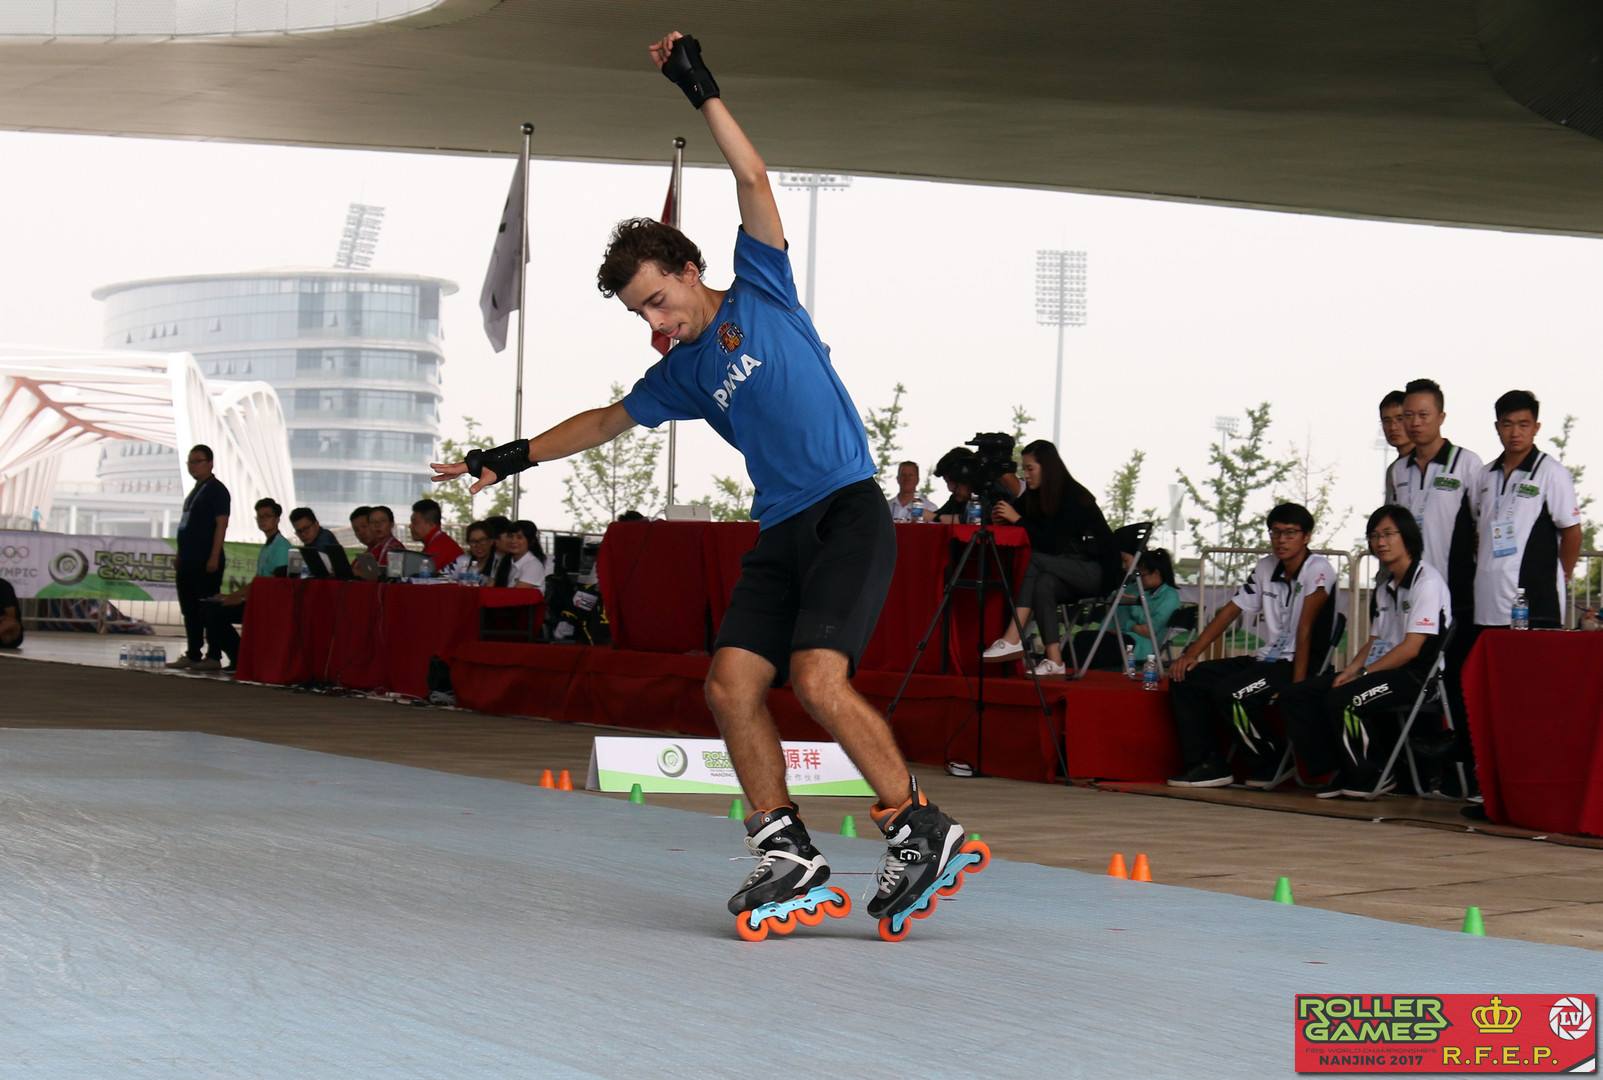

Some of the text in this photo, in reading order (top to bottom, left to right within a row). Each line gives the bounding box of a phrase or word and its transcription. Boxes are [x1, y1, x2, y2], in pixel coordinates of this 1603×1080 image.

[713, 354, 762, 412] PAÑA
[1240, 678, 1266, 697] FIRS
[1361, 683, 1389, 700] FIRS
[705, 760, 733, 769] GAM
[784, 748, 821, 769] 源祥
